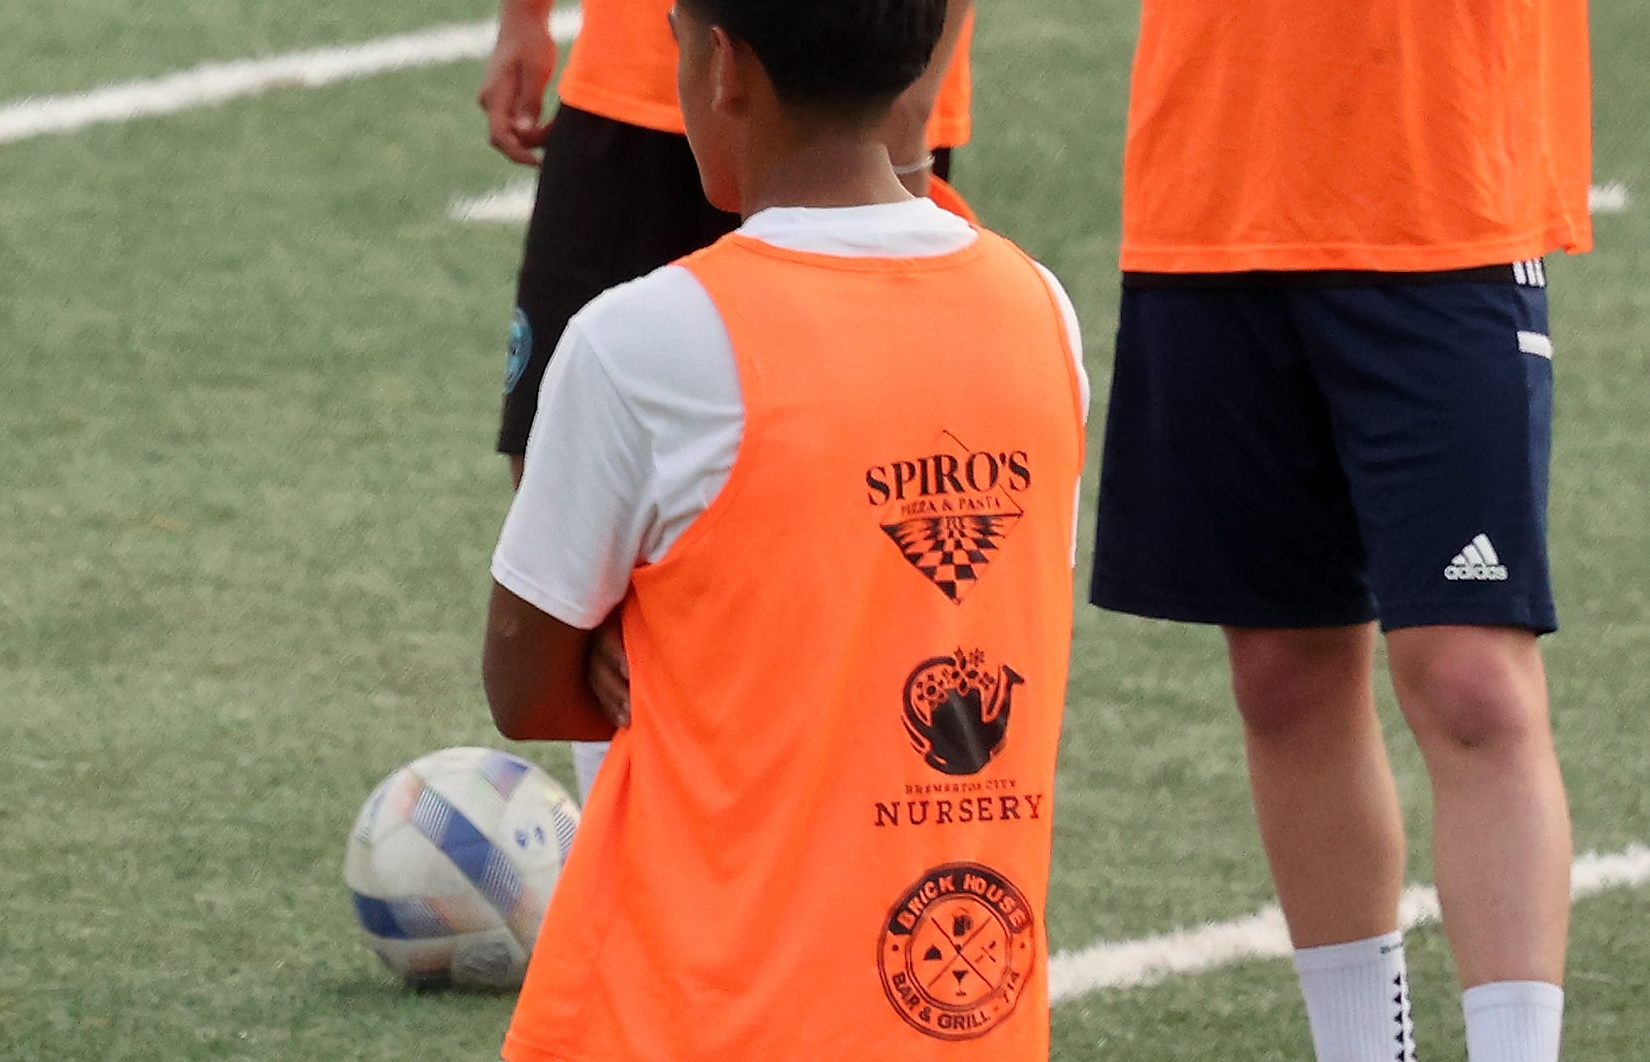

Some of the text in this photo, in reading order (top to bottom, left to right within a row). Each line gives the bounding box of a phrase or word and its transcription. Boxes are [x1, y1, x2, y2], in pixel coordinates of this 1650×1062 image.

[866, 451, 1031, 507] SPIRO'S
[942, 498, 953, 512] &
[958, 495, 1001, 511] PASTA
[1444, 564, 1508, 581] adidas
[875, 794, 1043, 827] NURSERY
[897, 873, 1027, 929] BRICK HOUSE
[892, 971, 991, 1031] BAR & GRILL
